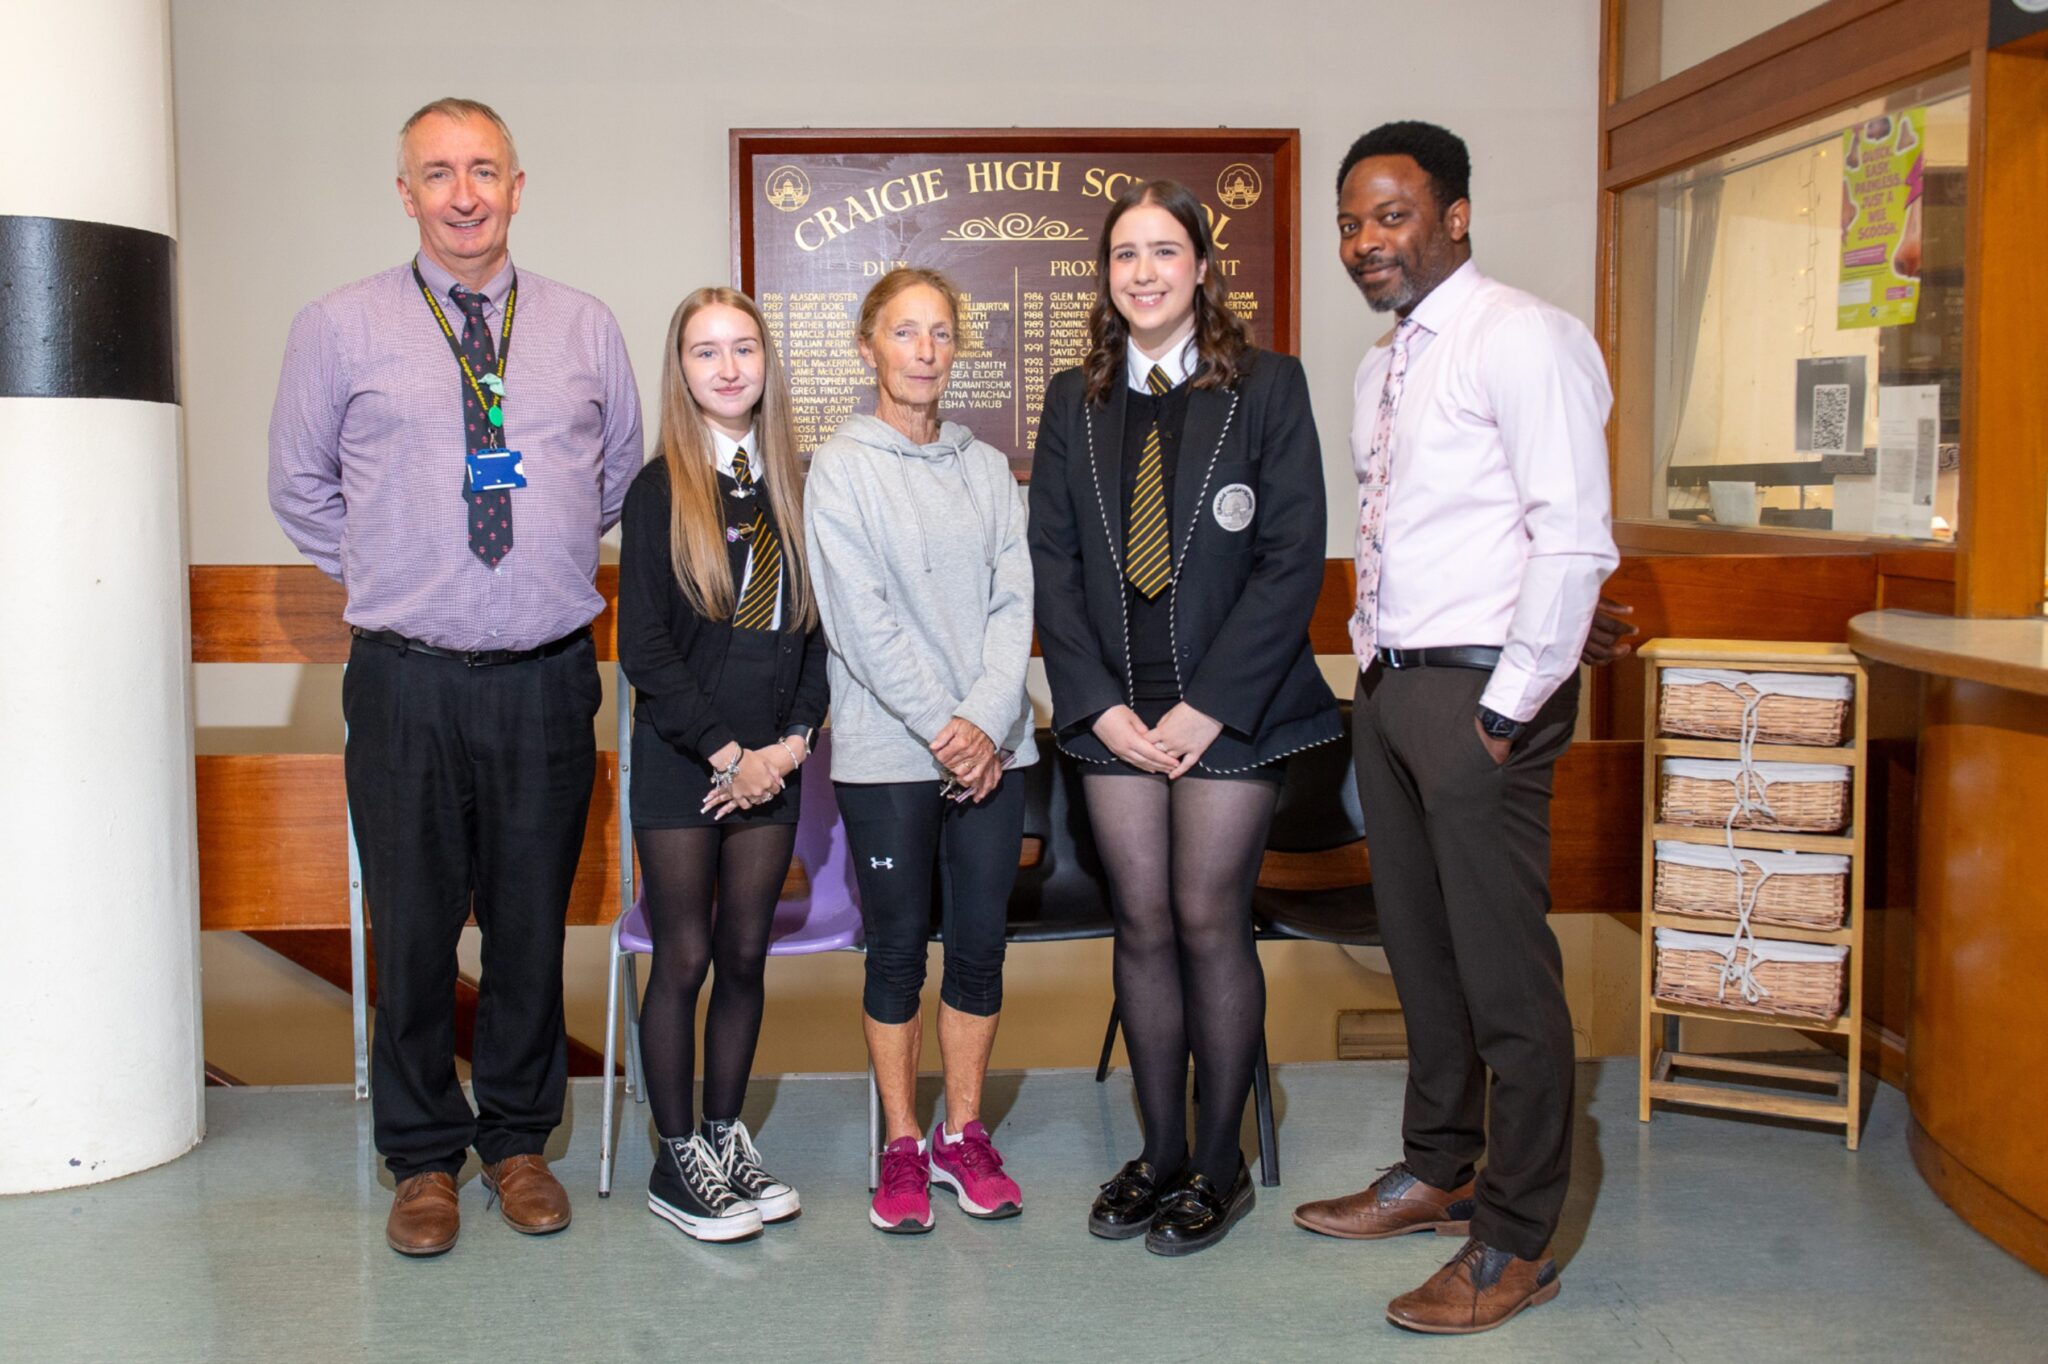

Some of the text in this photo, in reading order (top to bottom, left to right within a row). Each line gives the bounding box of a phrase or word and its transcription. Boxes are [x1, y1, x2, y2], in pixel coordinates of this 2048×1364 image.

[1862, 190, 1894, 208] JUST A
[794, 168, 948, 252] CRAIGIE
[966, 161, 1062, 194] HIGH
[1050, 260, 1098, 277] PROX
[763, 293, 784, 301] 1986
[828, 293, 858, 301] FOSTER
[1024, 292, 1044, 301] 1986
[1049, 292, 1073, 301] GLEN
[1228, 292, 1254, 300] ADAM
[763, 302, 845, 311] 1987 STUART DOIG
[1024, 301, 1044, 310] 1987
[1049, 301, 1080, 310] ALISON
[789, 312, 812, 320] PHILIP
[813, 312, 848, 320] LOUDEN
[1024, 311, 1090, 319] 1988 JENNIFER
[766, 321, 856, 329] 989 HEATHER RIVETT
[1024, 320, 1087, 329] 1989 DOMINIC
[789, 330, 824, 338] MARCUS
[1024, 329, 1089, 338] 1990 ANDREW
[790, 340, 823, 348] GILLIAN
[1024, 343, 1043, 352] 1991
[1049, 339, 1083, 347] PAULINE
[790, 349, 828, 357] MAGNUS
[830, 349, 859, 357] ALPHEY
[1049, 347, 1077, 356] DAVID
[790, 359, 809, 368] NEIL
[974, 361, 1007, 369] SMITH
[1024, 357, 1085, 366] 1992 JENNIFER
[791, 368, 814, 377] JAMIE
[972, 370, 1004, 379] ELDER
[1024, 366, 1044, 375] 1993
[791, 377, 877, 385] CHRISTOPHER BLACK
[1024, 375, 1044, 384] 1994
[952, 381, 1012, 389] ROMANTSCHUK
[1025, 384, 1045, 393] 1995
[791, 386, 854, 395] GREG FINDLAY
[971, 390, 1012, 399] MACHAJ
[792, 396, 861, 405] HANNAH ALPHEY
[968, 400, 1002, 409] YAKUB
[792, 405, 854, 414] HAZEL GRANT
[792, 415, 821, 424] ASHLEY
